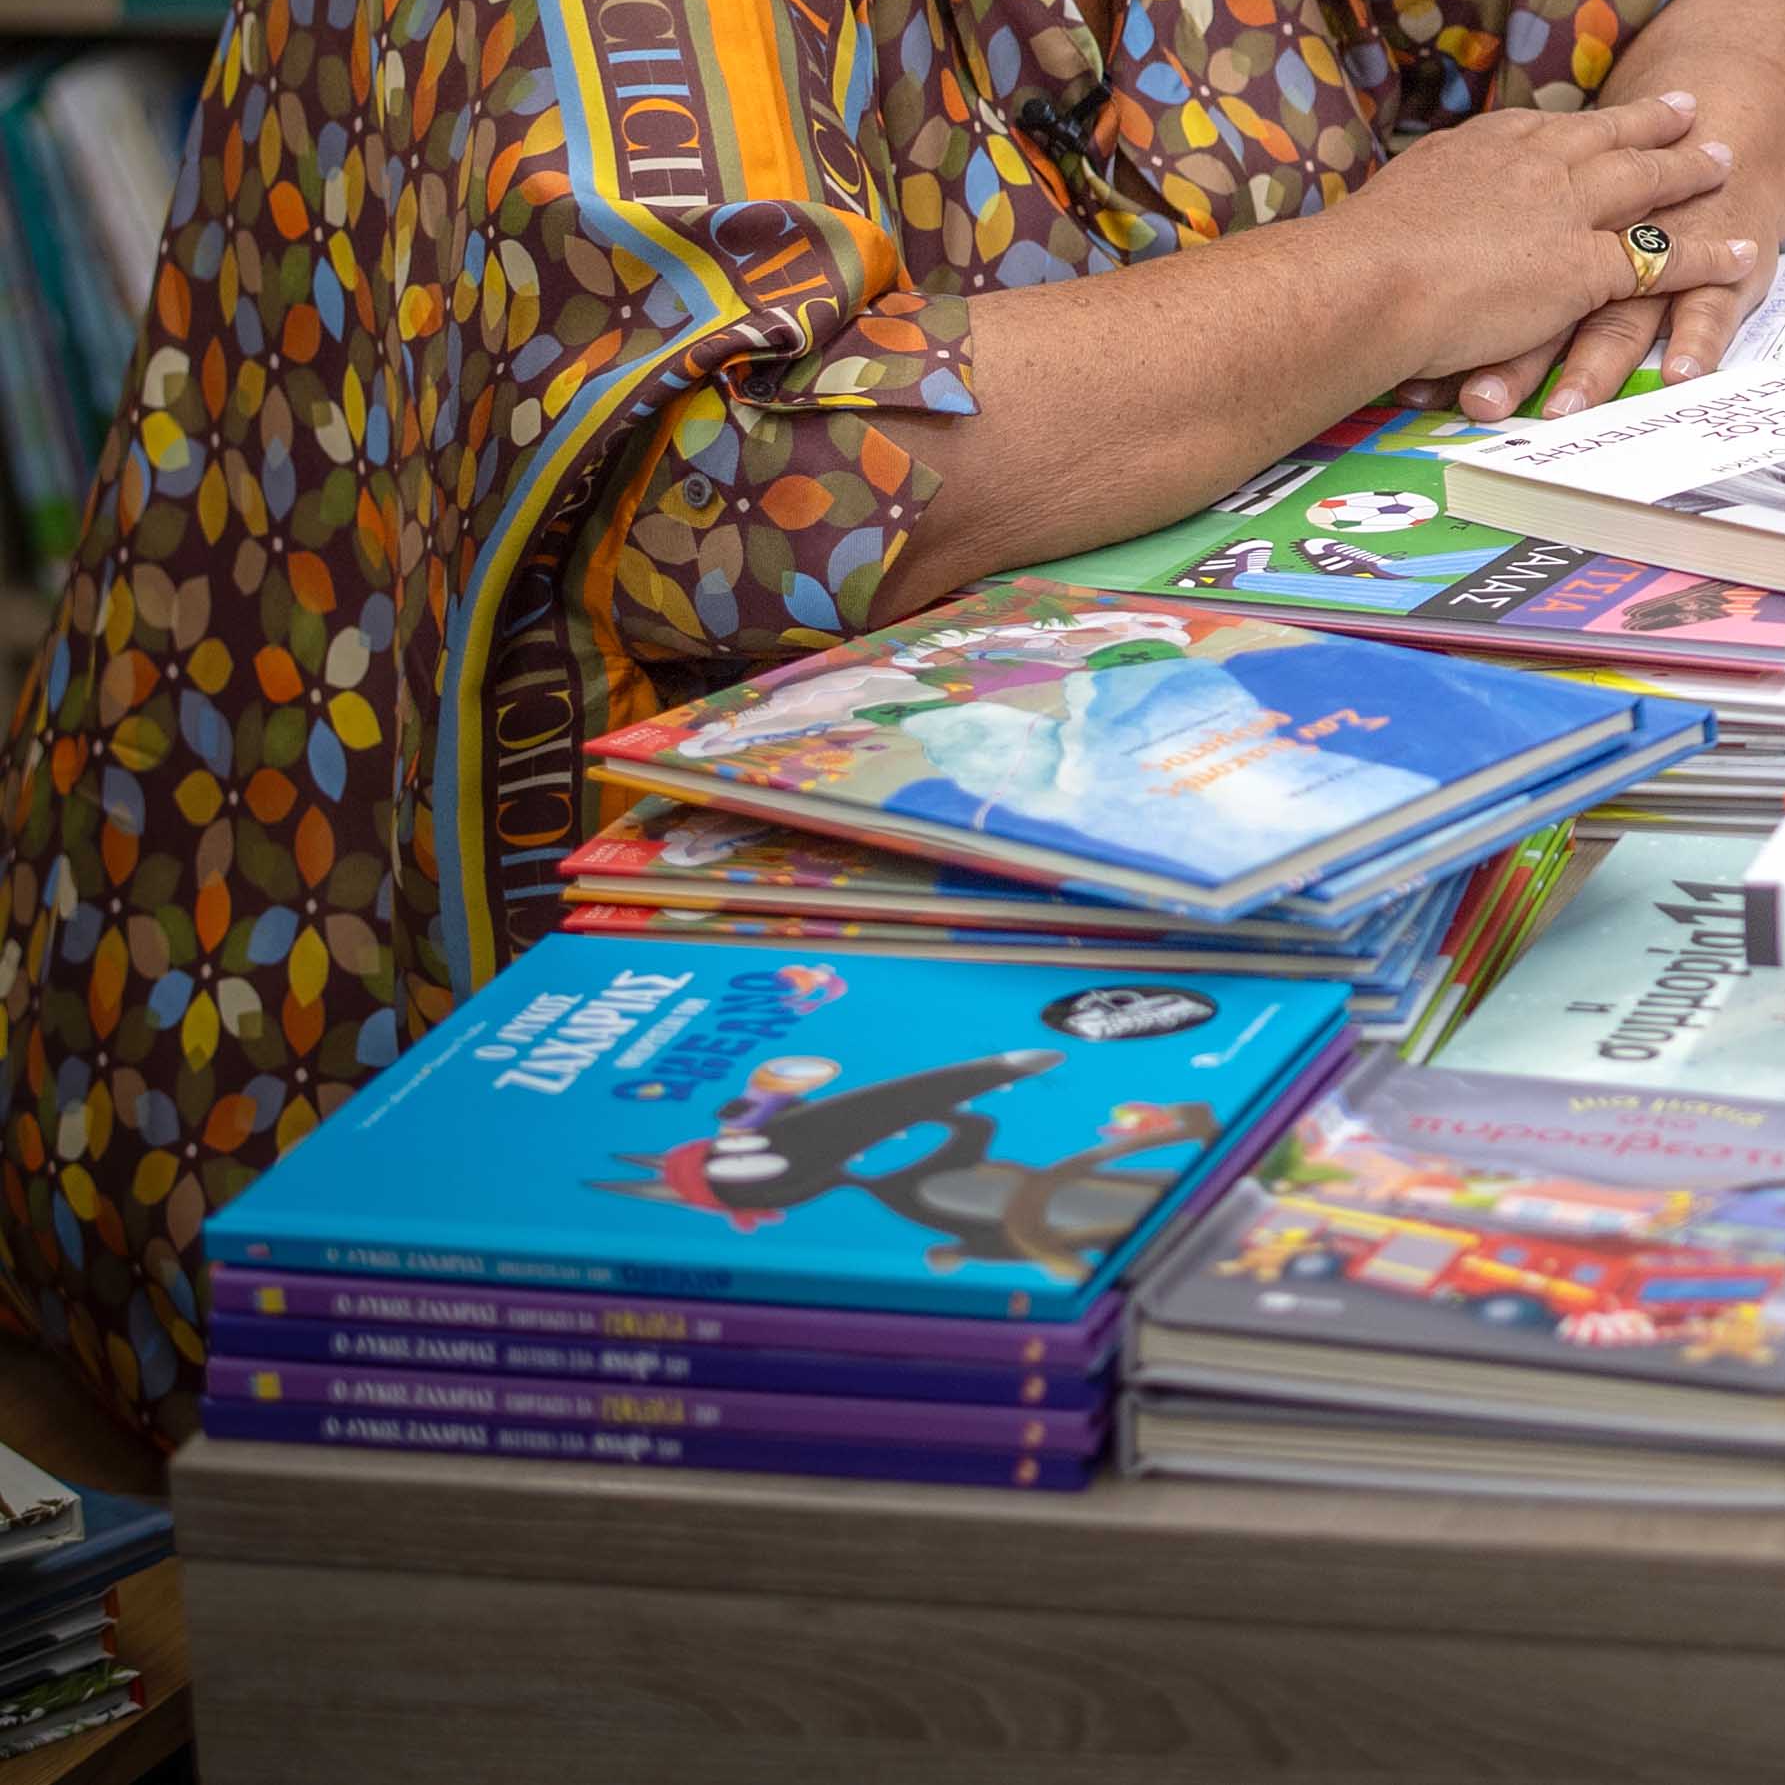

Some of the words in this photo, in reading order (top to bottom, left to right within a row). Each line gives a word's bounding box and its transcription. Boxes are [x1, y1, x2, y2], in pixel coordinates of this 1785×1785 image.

[1690, 404, 1774, 430] ΤΗΣ
[472, 1043, 517, 1061] Ο
[496, 992, 584, 1043] ΛΥΚΟΣ
[493, 968, 697, 1096] ΖΑΧΑΡΙΑΣ
[1597, 926, 1751, 1061] συμμορία
